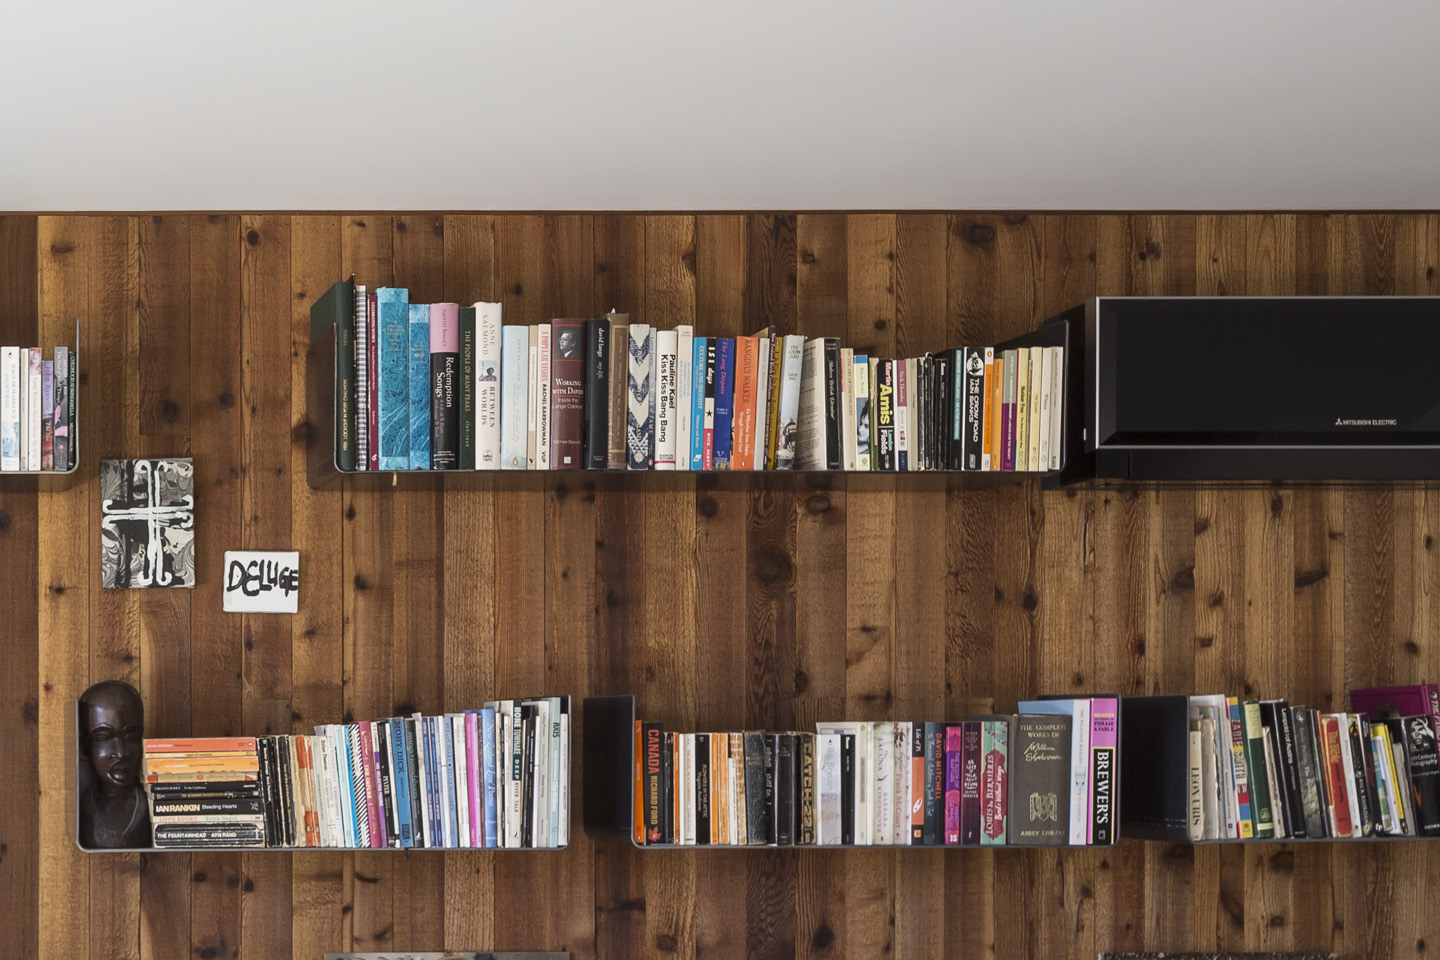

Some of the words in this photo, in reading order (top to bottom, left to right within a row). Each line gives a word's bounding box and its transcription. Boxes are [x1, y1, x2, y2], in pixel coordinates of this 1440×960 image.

[744, 339, 752, 374] RANGINUI
[436, 372, 444, 398] Songs
[445, 357, 454, 408] Redemption
[743, 376, 751, 404] WALKER
[880, 384, 892, 424] Amis
[552, 722, 560, 738] AXIS
[1231, 720, 1242, 746] ZADIE
[648, 729, 659, 774] CANADA
[1233, 751, 1246, 779] SMITH
[804, 743, 812, 827] CATCH-22
[826, 762, 835, 790] Bryson
[1096, 751, 1109, 824] BREWER'S
[1191, 767, 1200, 797] LEON
[1192, 800, 1201, 825] URIS
